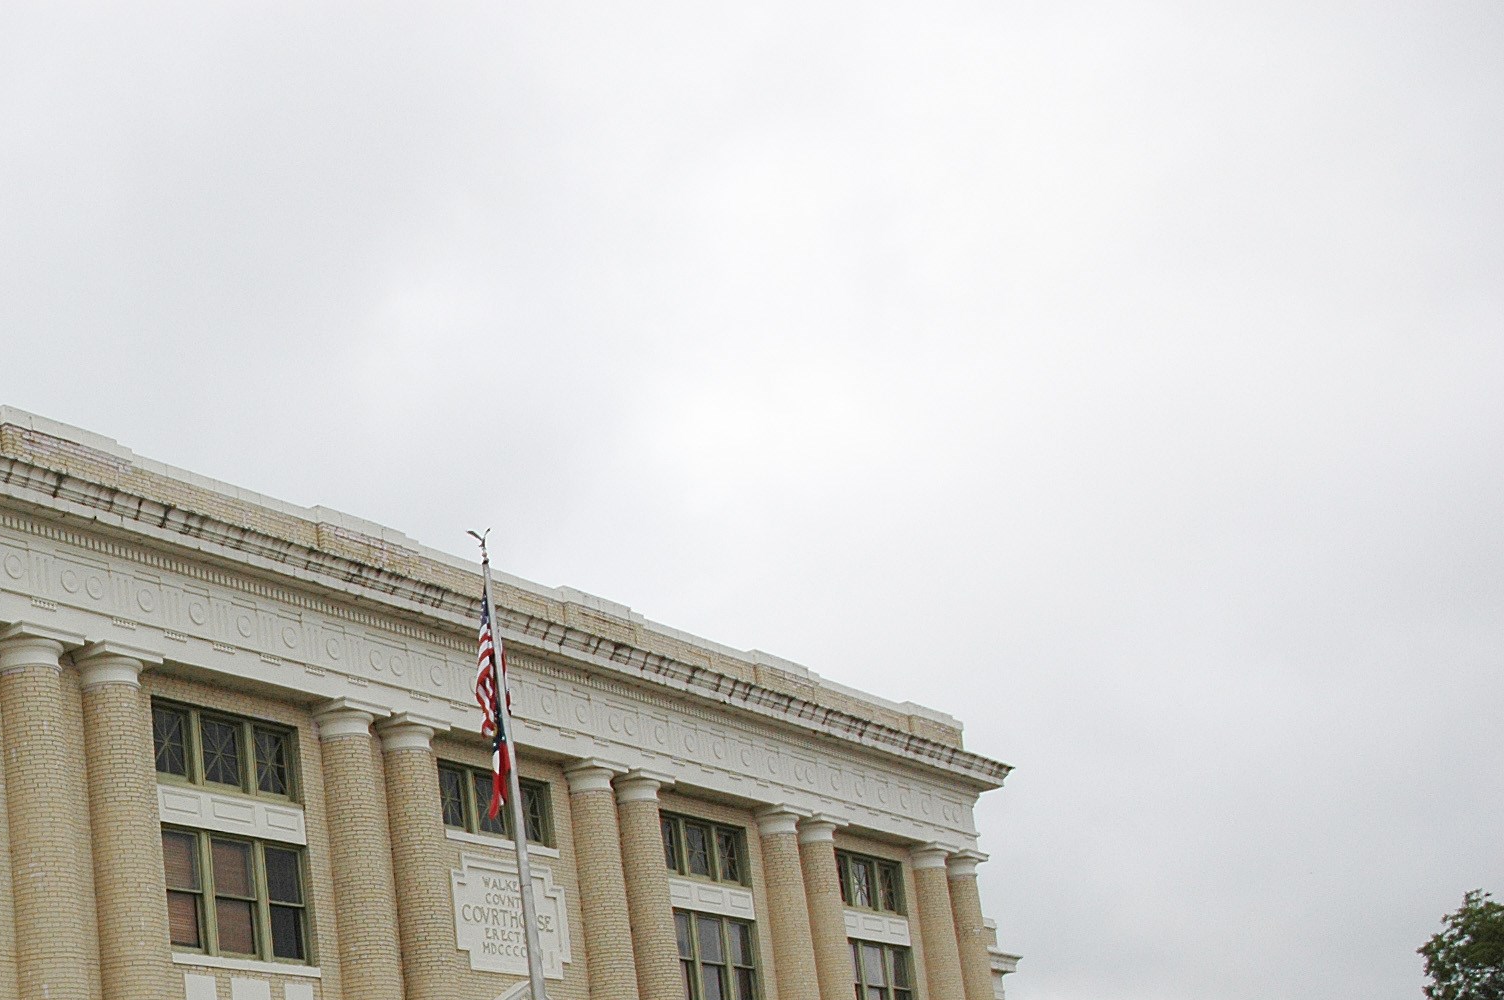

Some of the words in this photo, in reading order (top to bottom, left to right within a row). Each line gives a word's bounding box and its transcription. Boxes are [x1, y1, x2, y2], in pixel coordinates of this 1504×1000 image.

[482, 876, 520, 893] WALKE
[485, 893, 522, 909] COVNT
[461, 903, 554, 933] COVRTHOSE
[484, 927, 527, 944] ERECT
